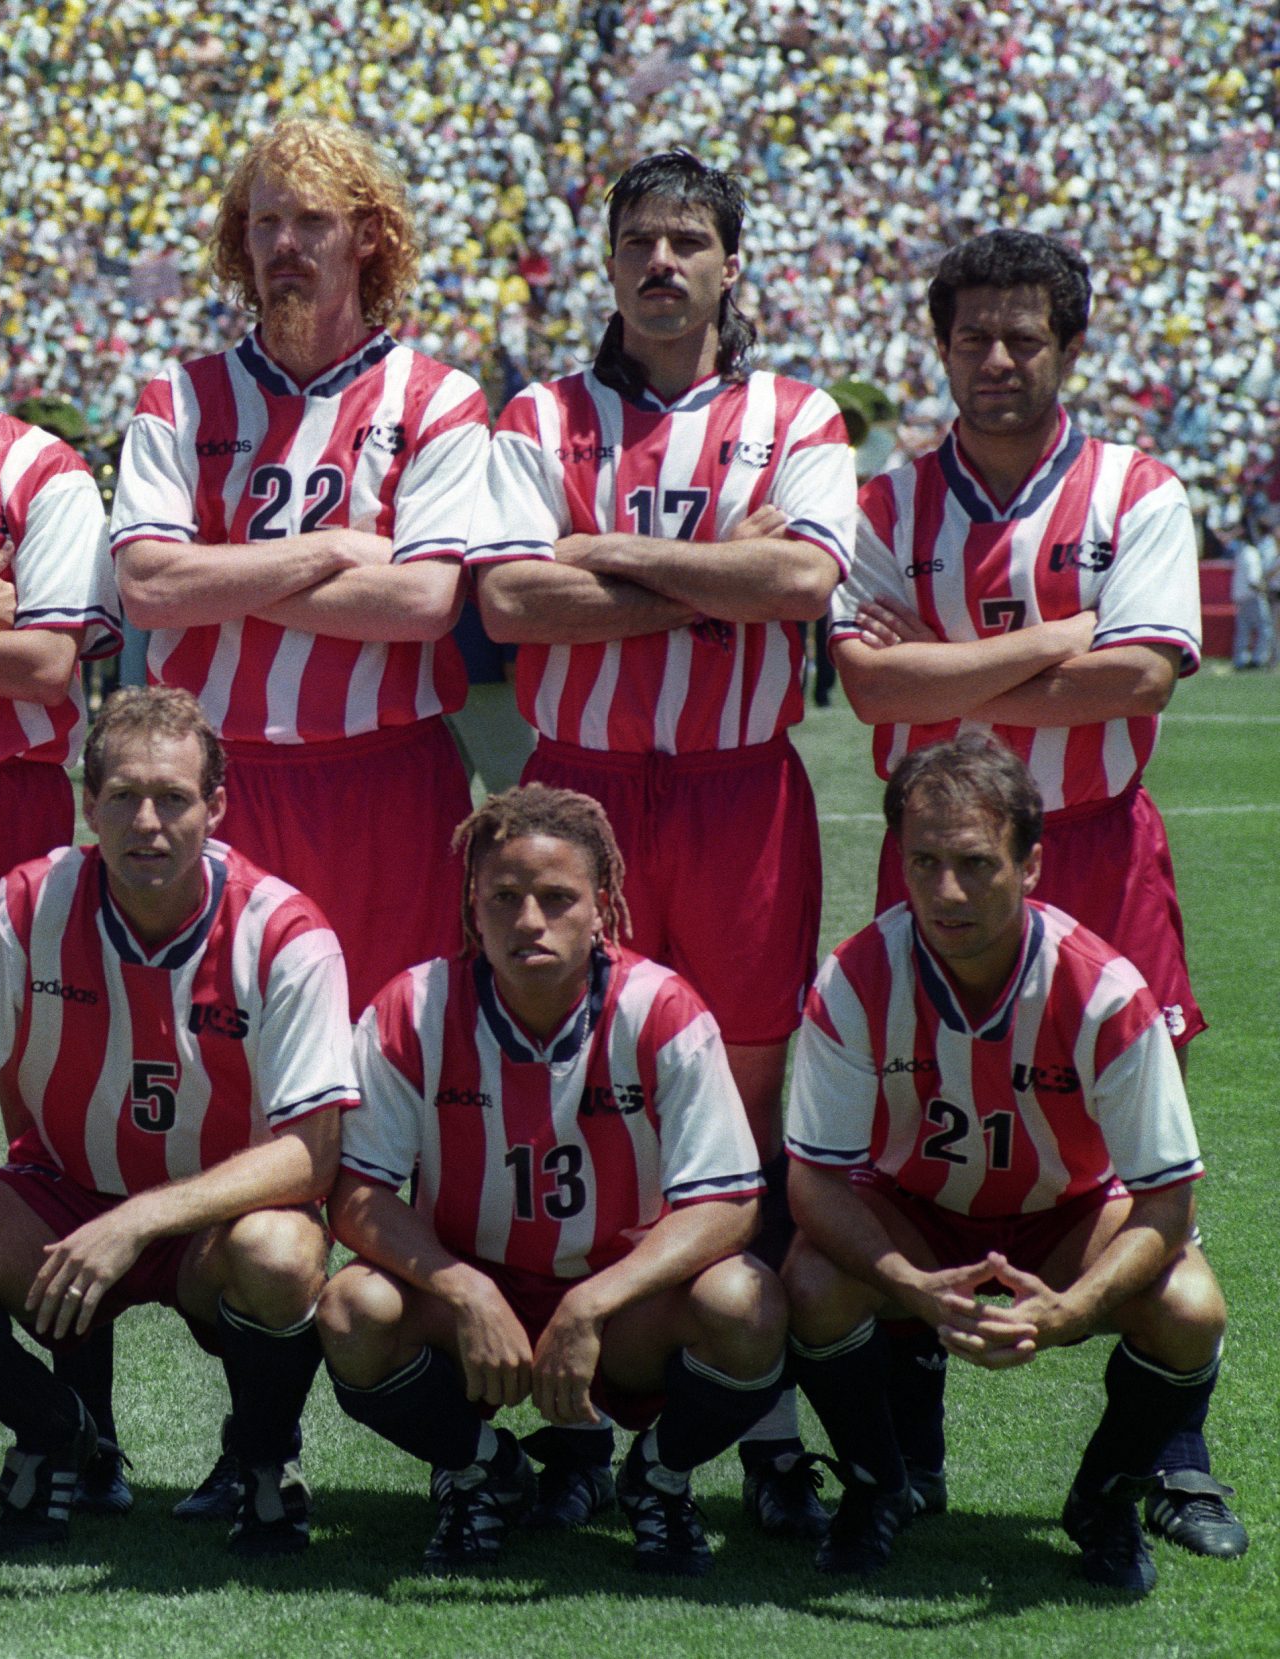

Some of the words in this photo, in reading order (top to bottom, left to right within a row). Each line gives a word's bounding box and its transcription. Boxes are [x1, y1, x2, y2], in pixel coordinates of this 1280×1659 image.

[195, 438, 253, 458] adidas
[248, 464, 344, 540] 22
[626, 486, 710, 541] 17
[981, 597, 1027, 633] 7
[30, 978, 98, 1004] adidas
[188, 1002, 250, 1040] US
[131, 1060, 178, 1134] 5
[1011, 1062, 1081, 1095] US
[923, 1099, 1015, 1170] 21
[504, 1143, 587, 1222] 13
